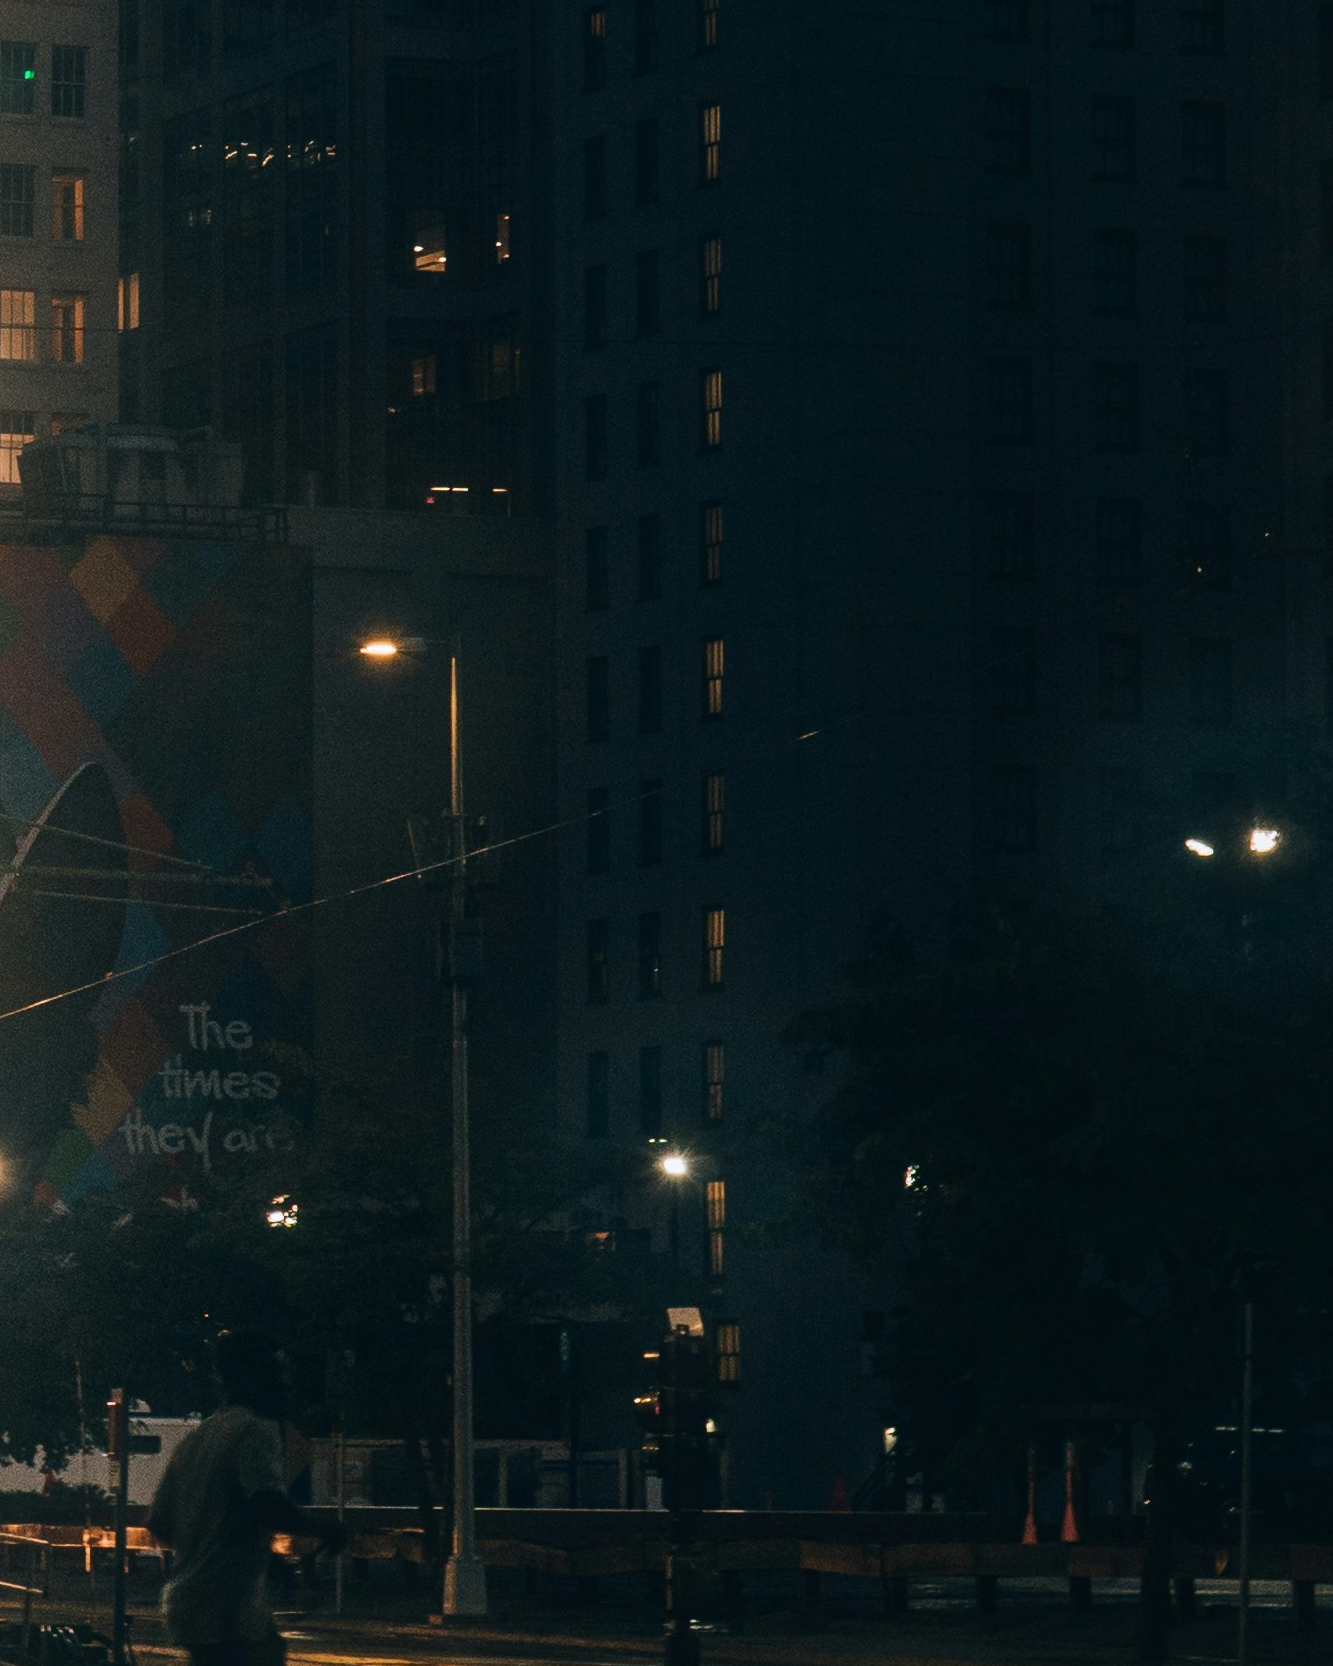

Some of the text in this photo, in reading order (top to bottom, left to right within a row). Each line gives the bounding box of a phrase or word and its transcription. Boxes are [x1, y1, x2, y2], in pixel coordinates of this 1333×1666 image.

[180, 1000, 253, 1051] The
[158, 1053, 281, 1100] times
[117, 1107, 213, 1173] they
